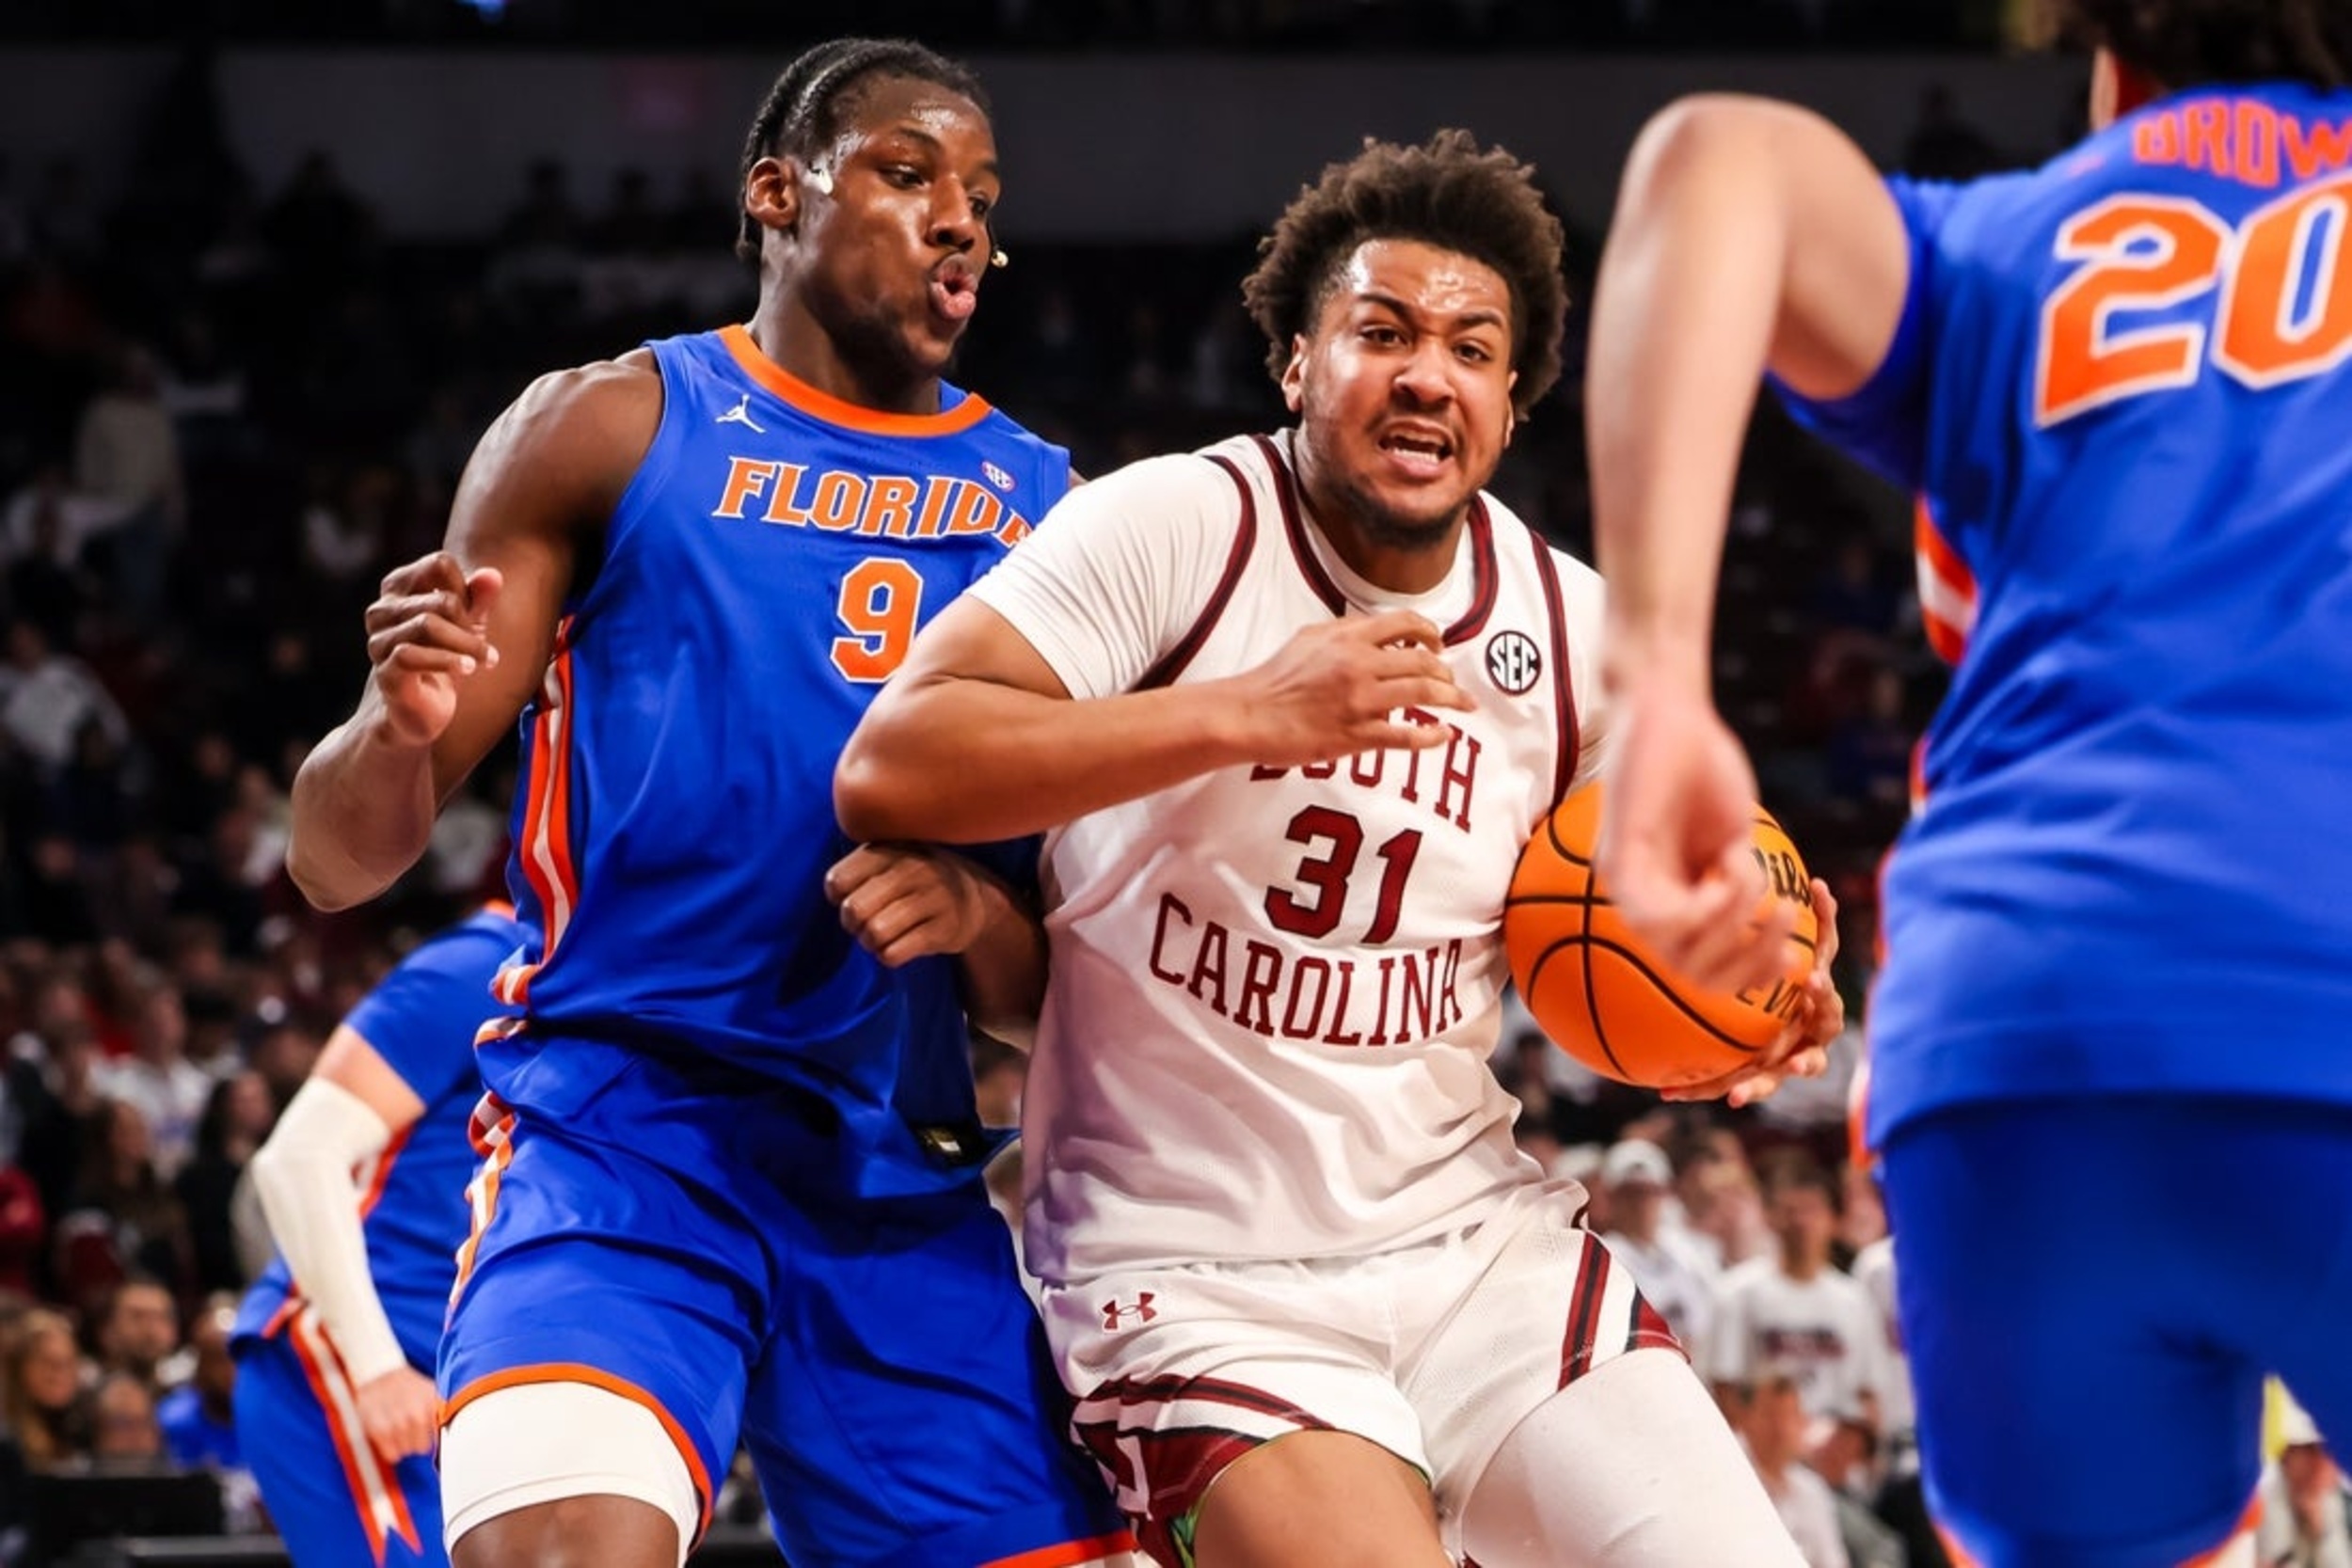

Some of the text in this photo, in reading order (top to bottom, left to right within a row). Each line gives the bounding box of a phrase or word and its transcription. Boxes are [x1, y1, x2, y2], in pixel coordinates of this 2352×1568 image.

[2034, 169, 2352, 431] 20
[831, 556, 924, 684] 9
[1486, 630, 1542, 695] SEC
[1263, 804, 1423, 943] 31
[1149, 892, 1463, 1045] CAROLINA
